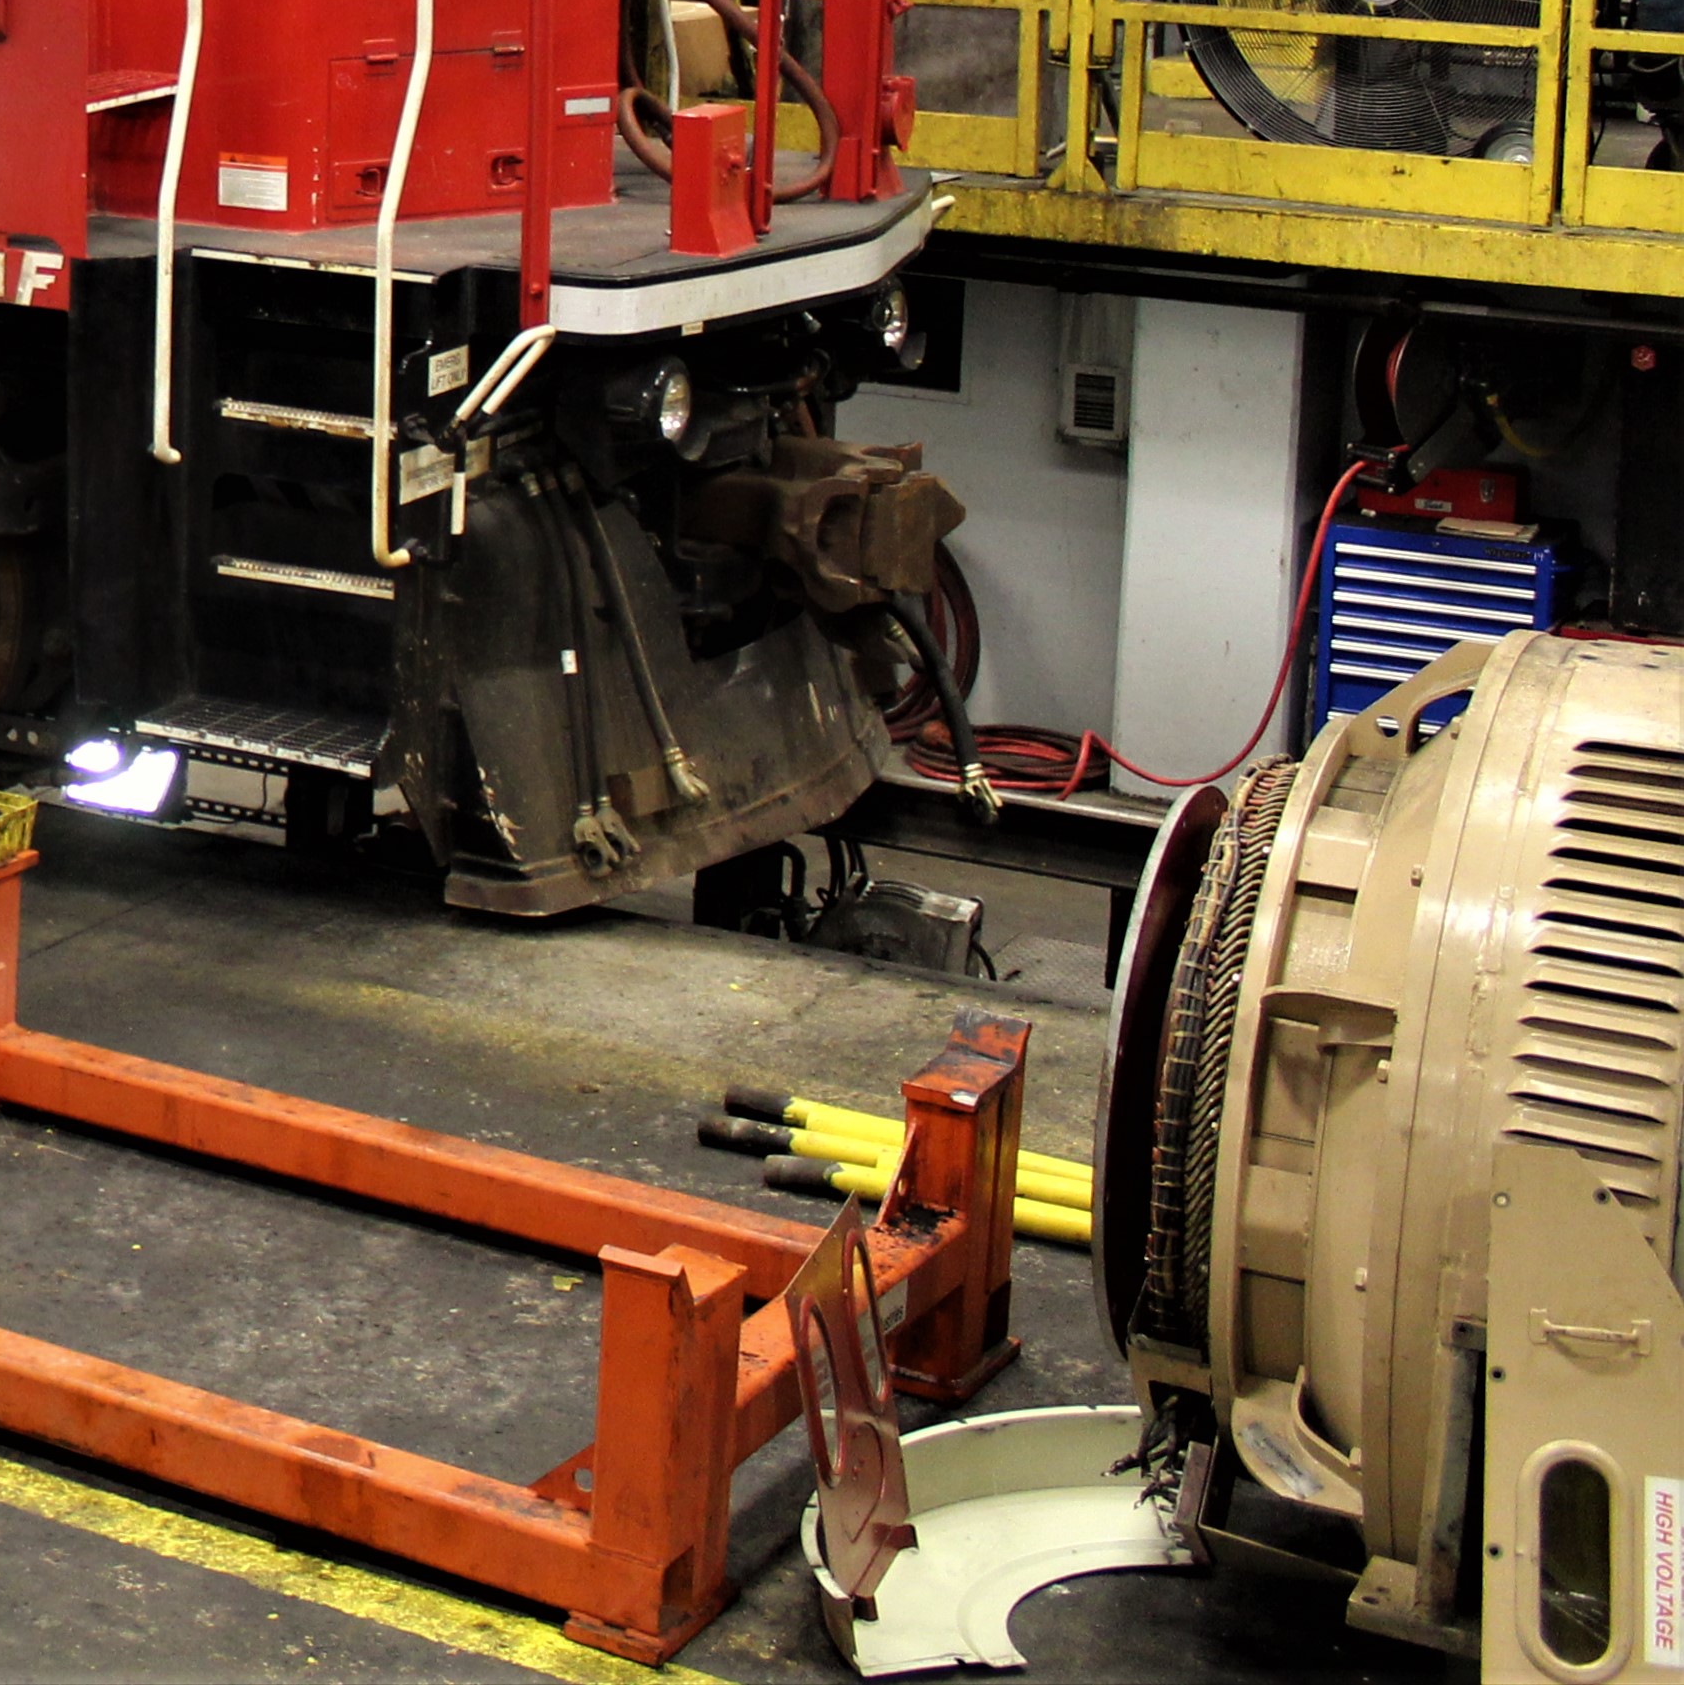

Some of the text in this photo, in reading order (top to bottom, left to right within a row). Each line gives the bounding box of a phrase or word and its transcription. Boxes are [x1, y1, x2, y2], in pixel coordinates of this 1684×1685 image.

[15, 251, 64, 306] F
[1655, 1490, 1674, 1650] HIGH VOLTAGE
